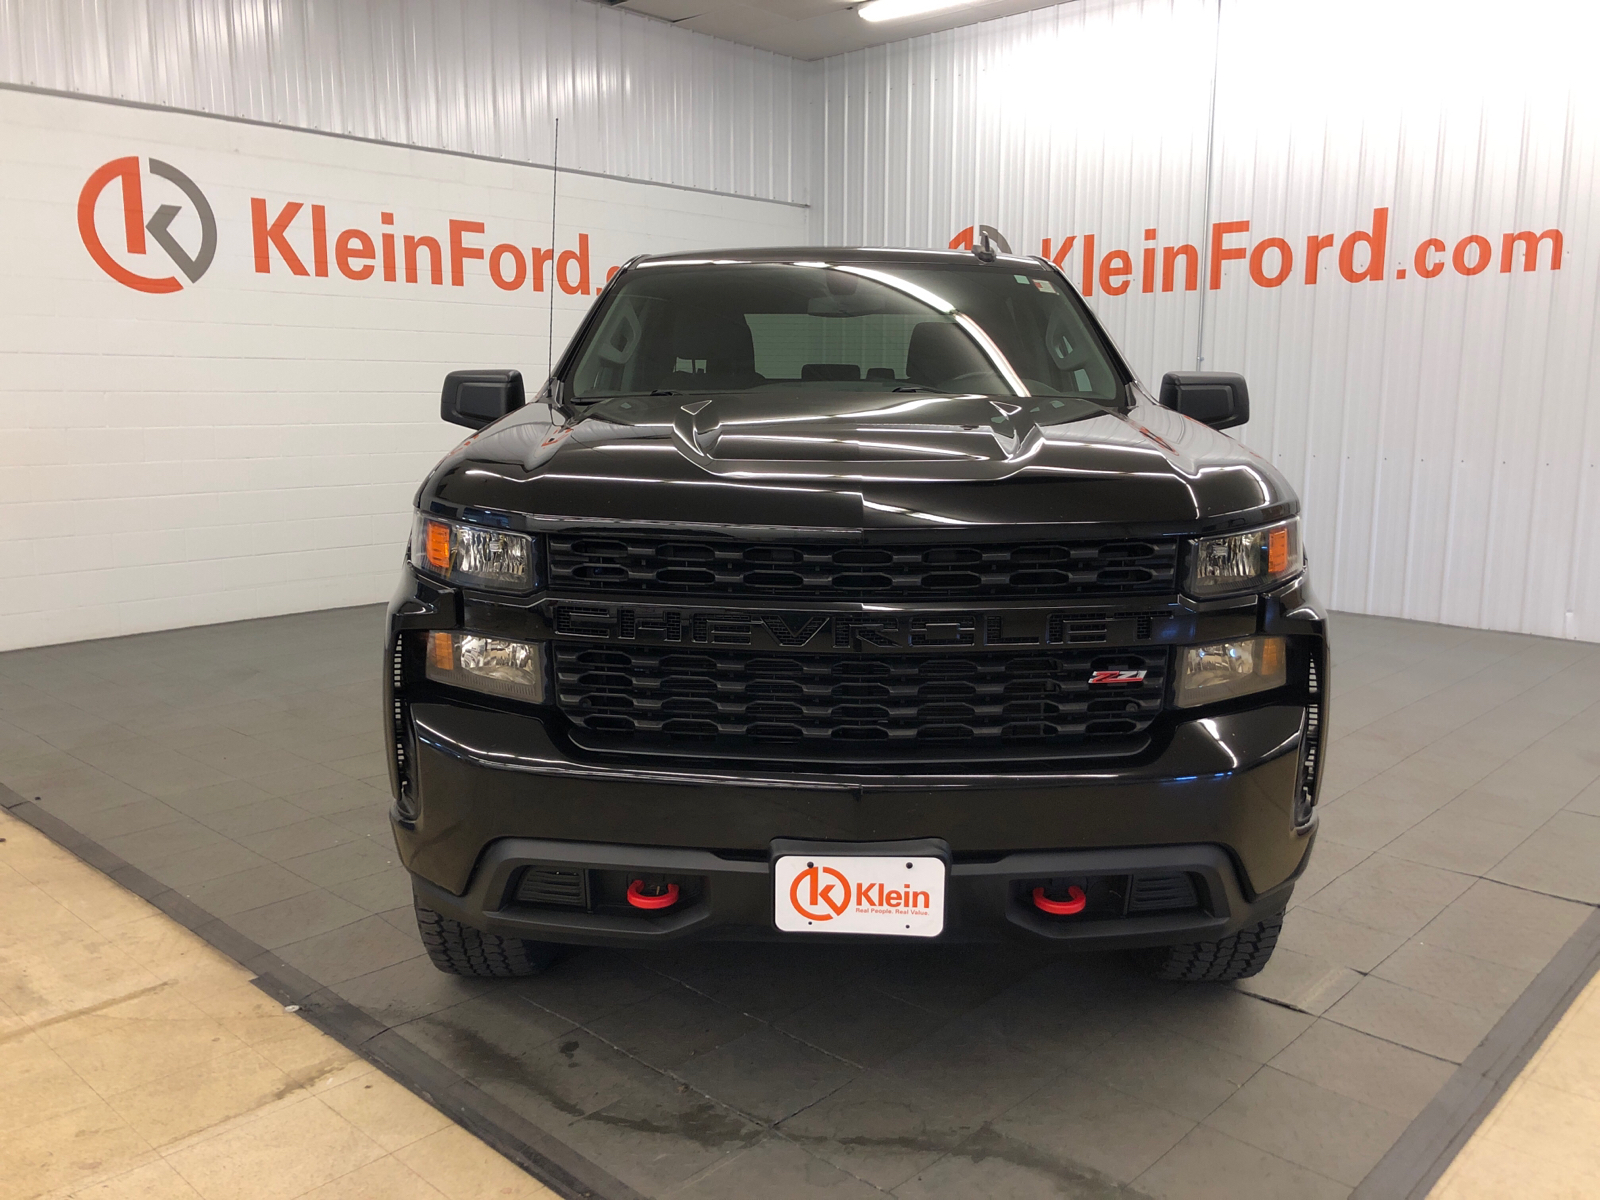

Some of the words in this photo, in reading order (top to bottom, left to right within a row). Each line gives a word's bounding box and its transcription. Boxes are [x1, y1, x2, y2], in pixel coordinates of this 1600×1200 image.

[1041, 208, 1564, 298] KleinFord.com
[554, 604, 1173, 649] CHEVROLET
[856, 882, 930, 909] Klein
[871, 908, 893, 916] People.
